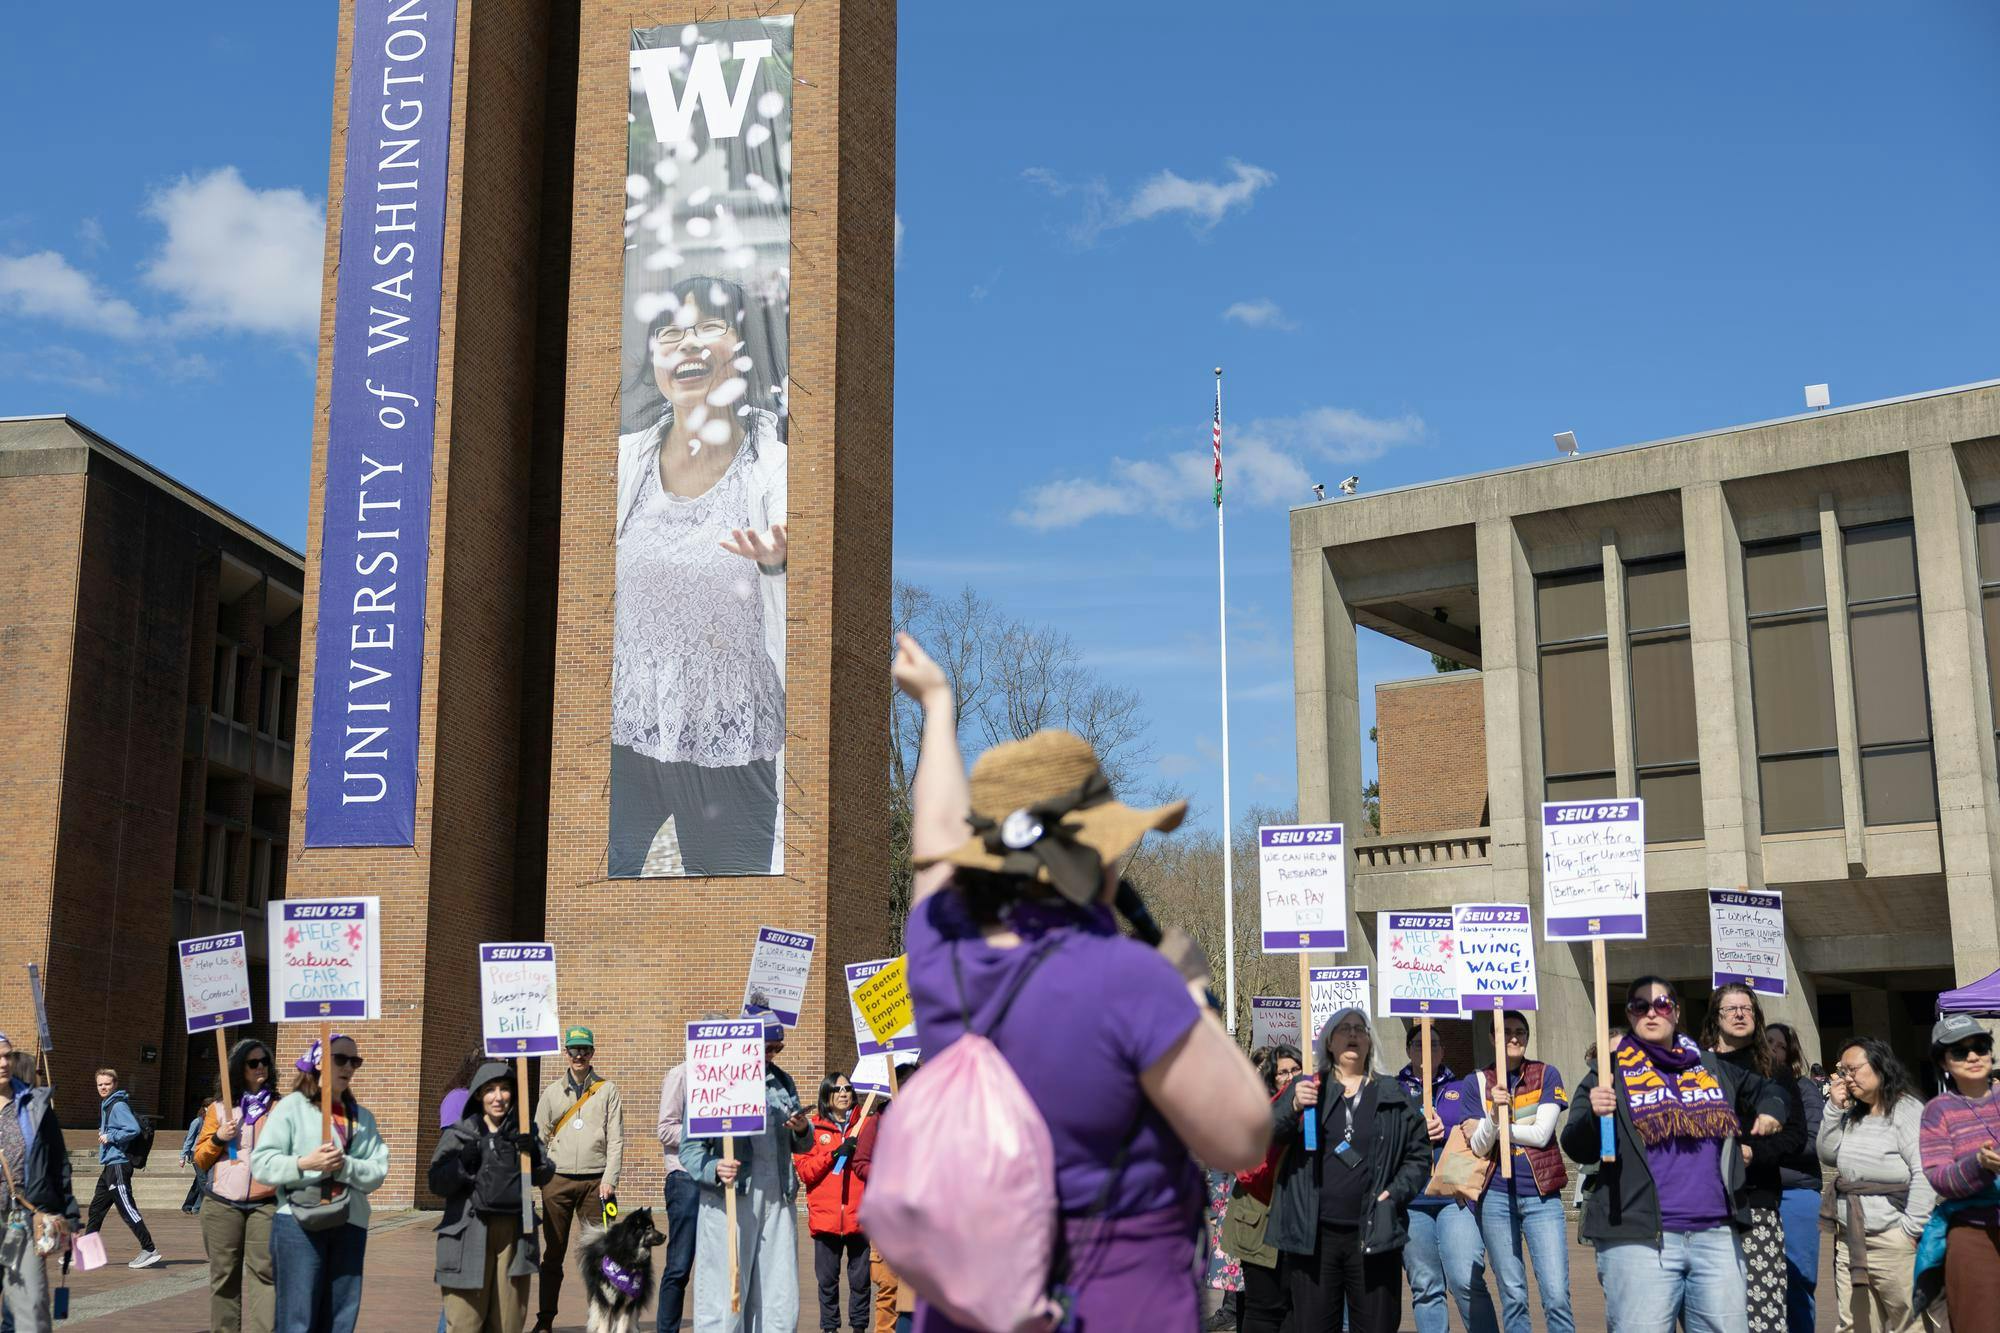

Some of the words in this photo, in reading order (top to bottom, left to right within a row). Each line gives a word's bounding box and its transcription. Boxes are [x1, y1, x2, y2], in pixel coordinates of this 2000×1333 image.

[629, 38, 772, 143] W
[367, 0, 428, 357] WASHINGTON
[366, 378, 419, 429] of
[342, 453, 403, 806] UNIVERSITY
[1555, 807, 1595, 821] SEIU
[1597, 806, 1629, 819] 925
[1271, 832, 1305, 844] SEIU
[1307, 830, 1334, 842] 925
[1550, 831, 1562, 846] I
[1567, 830, 1600, 846] work
[1602, 826, 1622, 845] for
[1625, 836, 1636, 844] a
[1264, 854, 1280, 863] WE
[1282, 854, 1300, 862] CAN
[1304, 852, 1326, 862] HELP
[1556, 850, 1599, 871] Top-Tier
[1278, 868, 1328, 880] RESEARCH
[1577, 866, 1601, 878] with
[1614, 878, 1630, 899] Pay
[1266, 890, 1300, 908] FAIR
[1304, 888, 1324, 906] PAY
[1720, 893, 1748, 904] SEIU
[1750, 896, 1773, 906] 925
[294, 906, 327, 918] SEIU
[330, 905, 357, 917] 925
[1464, 911, 1495, 921] SEIU
[1496, 911, 1521, 921] 925
[1716, 909, 1725, 920] I
[1728, 911, 1753, 921] work
[1753, 910, 1768, 924] for
[1397, 917, 1426, 927] SEIU
[1428, 918, 1451, 927] 925
[298, 922, 341, 942] HELP
[1405, 930, 1440, 943] HELP
[1720, 926, 1755, 937] TOP-TIER
[188, 941, 214, 953] SEIU
[216, 937, 237, 949] 925
[320, 940, 340, 952] US
[765, 932, 790, 944] SEIU
[790, 937, 808, 948] 925
[1736, 940, 1752, 949] with
[491, 949, 521, 959] SEIU
[522, 948, 546, 959] 925
[1413, 944, 1432, 957] US
[1459, 941, 1521, 957] LIVING
[195, 960, 213, 970] Help
[215, 957, 229, 966] Us
[1466, 960, 1530, 974] WAGE!
[302, 968, 339, 982] FAIR
[489, 963, 550, 987] Prestige
[855, 966, 880, 977] SEIU
[1316, 971, 1340, 980] SEIU
[1341, 970, 1361, 979] 925
[860, 990, 872, 1002] Do
[872, 968, 901, 992] Better
[1409, 972, 1441, 987] FAIR
[1477, 976, 1527, 993] NOW!
[200, 984, 238, 1001] Contract!
[289, 981, 359, 1000] CONTRACT
[528, 991, 548, 1003] pay
[865, 1000, 881, 1013] For
[881, 982, 904, 1000] Your
[1311, 984, 1333, 1001] UW
[1333, 988, 1362, 1001] NOT
[1393, 985, 1456, 998] CONTRACT
[872, 992, 912, 1024] Employe
[1311, 1001, 1345, 1013] WANT
[1349, 1000, 1364, 1009] TO
[498, 1013, 541, 1033] Bills!
[1259, 1011, 1295, 1020] LIVING
[696, 1026, 728, 1038] SEIU
[729, 1025, 755, 1036] 925
[878, 1017, 898, 1035] UW!
[1267, 1033, 1299, 1046] NOW
[693, 1042, 732, 1059] HELP
[742, 1043, 760, 1056] US
[696, 1062, 763, 1082] SAKURA
[691, 1087, 732, 1104] FAIR
